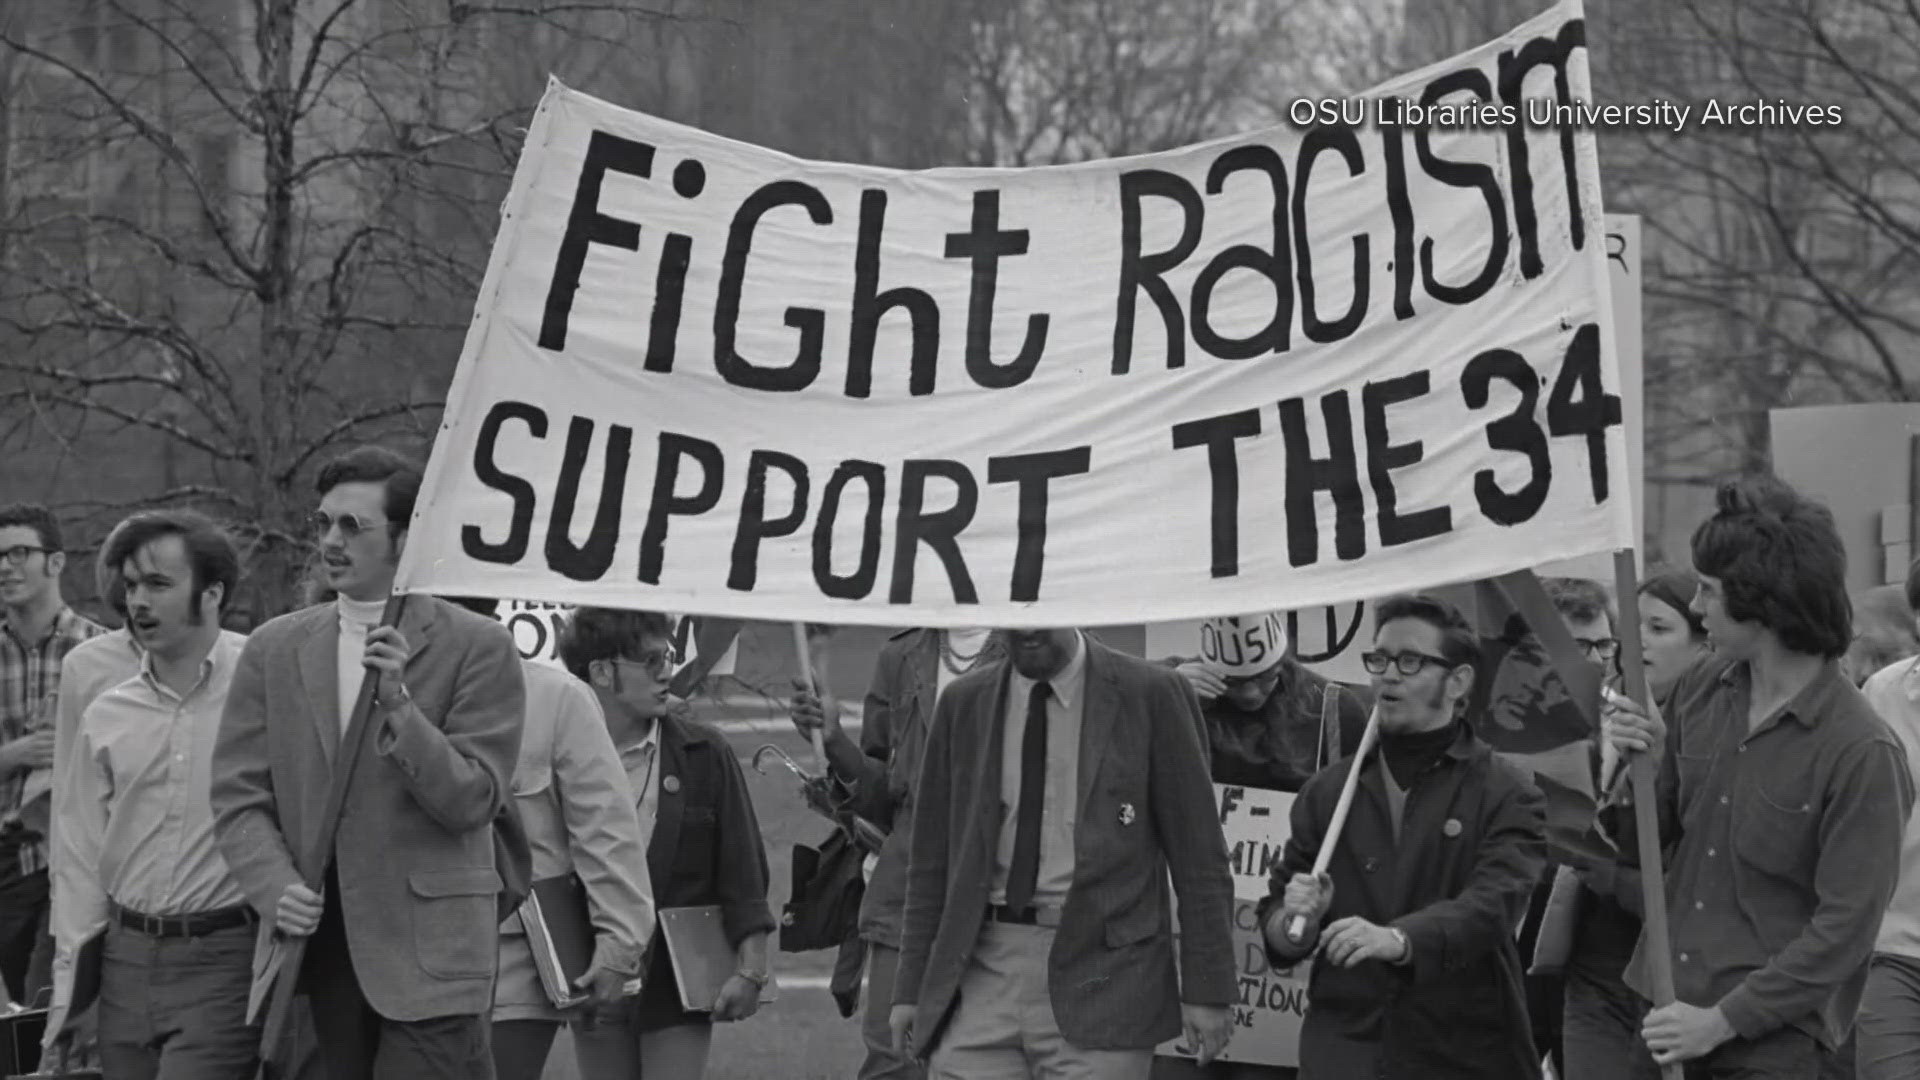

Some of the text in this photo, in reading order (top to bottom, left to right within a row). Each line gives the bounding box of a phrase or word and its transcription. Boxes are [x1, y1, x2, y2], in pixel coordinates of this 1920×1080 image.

[461, 322, 1623, 606] SUPPORT THE 34
